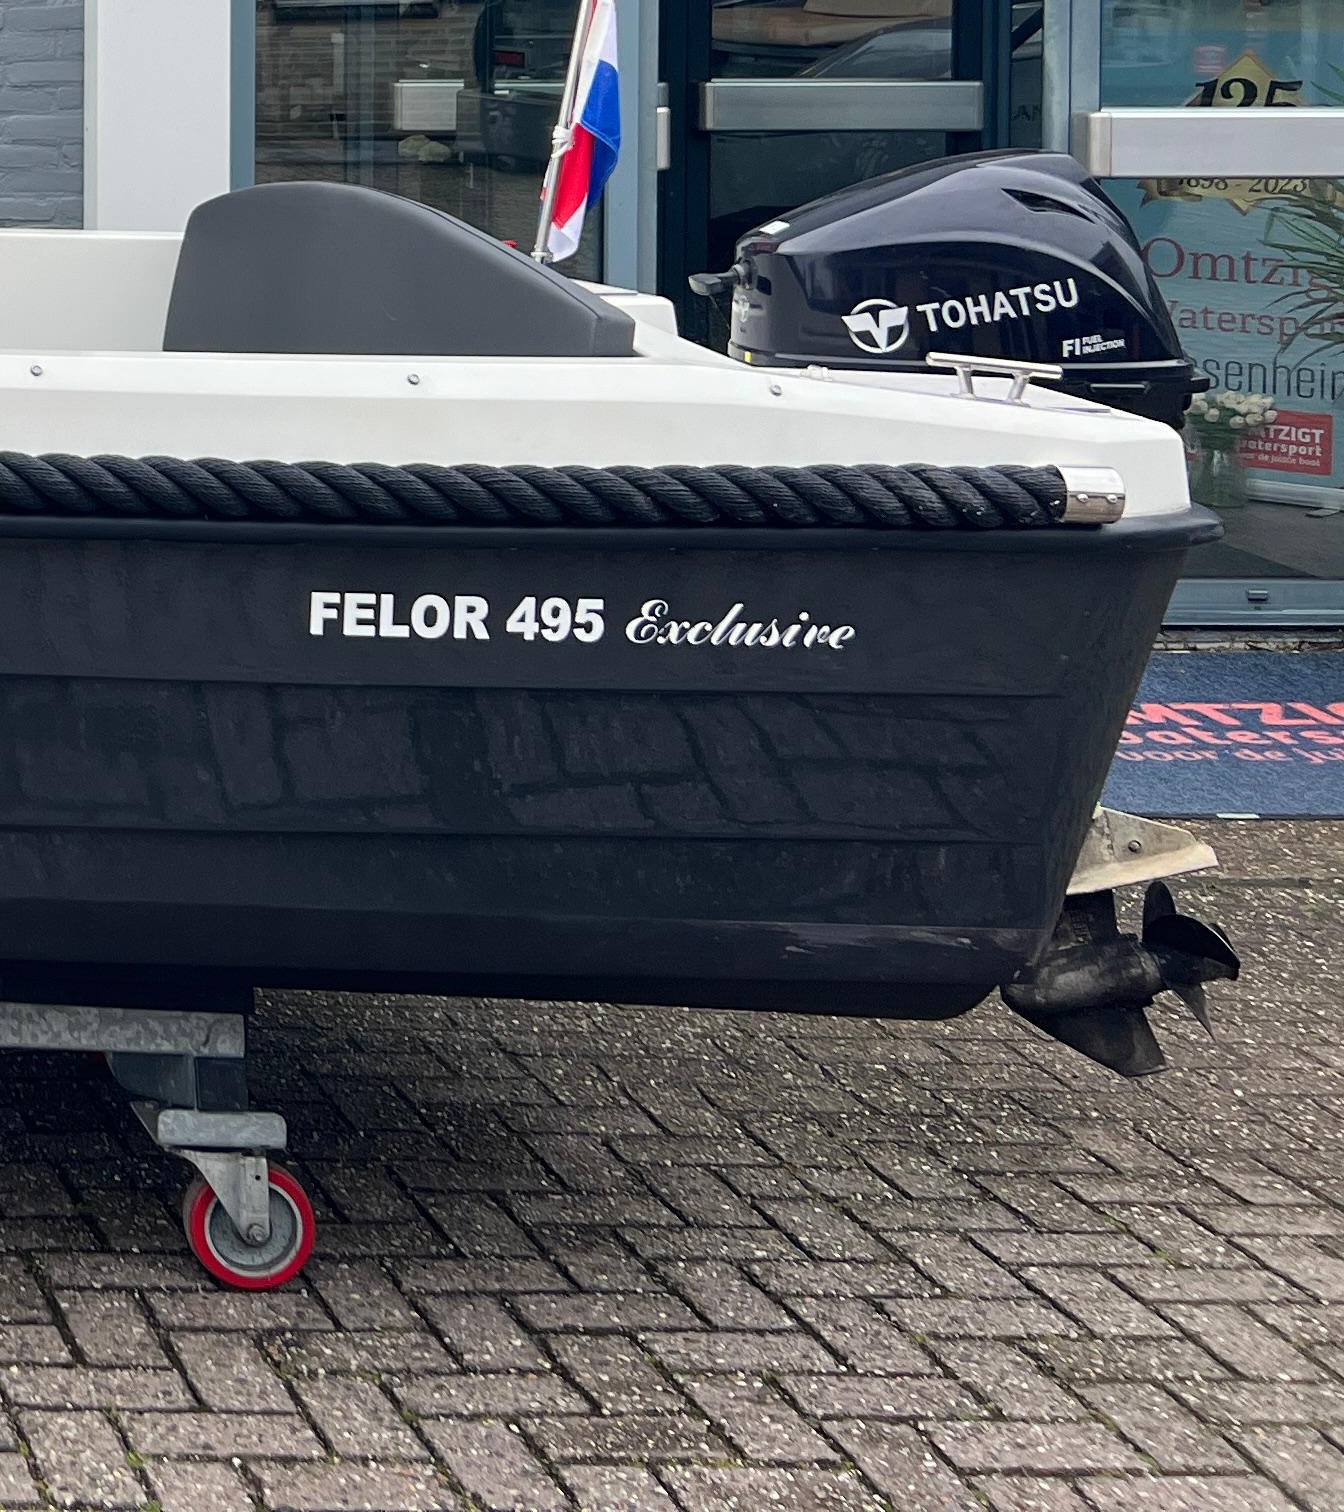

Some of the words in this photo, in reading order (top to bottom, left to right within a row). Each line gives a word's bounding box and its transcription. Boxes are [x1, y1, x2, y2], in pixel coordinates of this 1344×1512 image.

[916, 277, 1079, 333] TOHATSU
[1062, 338, 1081, 358] FI
[308, 591, 490, 640] FELOR
[505, 596, 605, 643] 495
[624, 598, 856, 651] Exclusive
[1233, 748, 1293, 762] de
